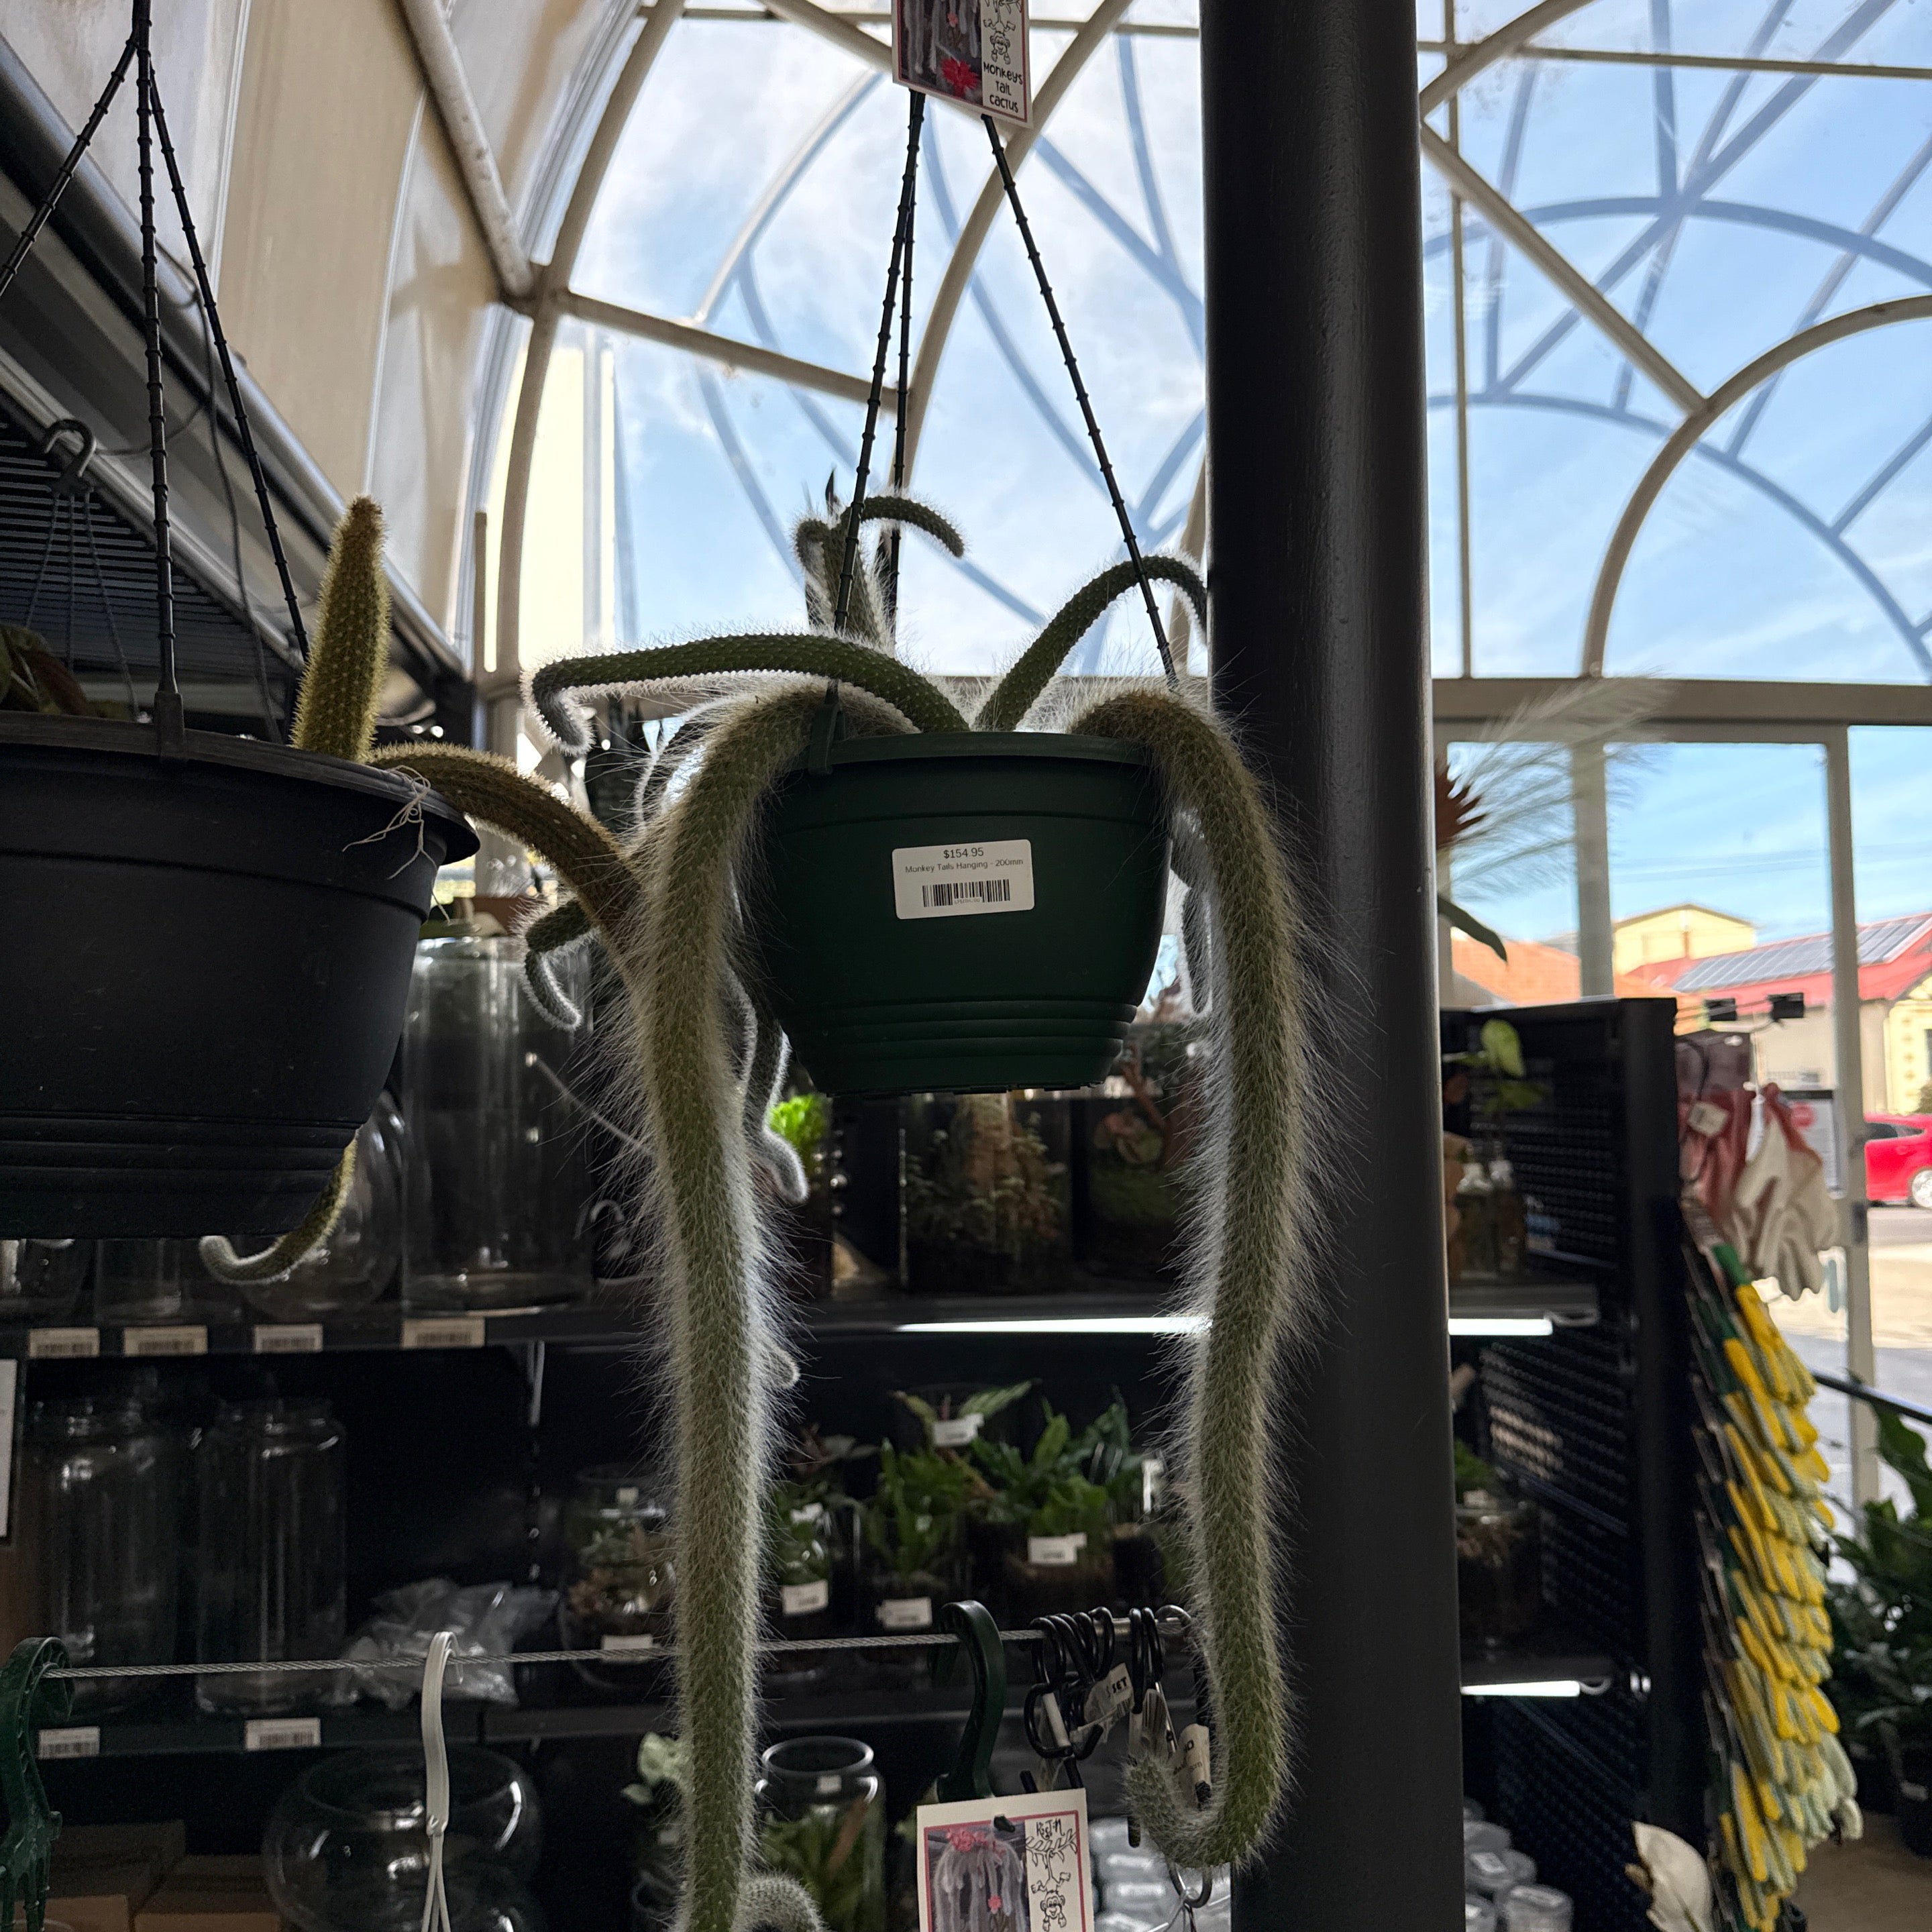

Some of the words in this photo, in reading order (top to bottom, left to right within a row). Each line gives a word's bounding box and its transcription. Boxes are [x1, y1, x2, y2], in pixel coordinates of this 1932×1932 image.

[943, 847, 984, 859] $154.95
[905, 864, 934, 873] Monkey
[937, 863, 954, 871] Tails
[957, 861, 988, 869] Hanging
[995, 859, 1024, 867] 200mm
